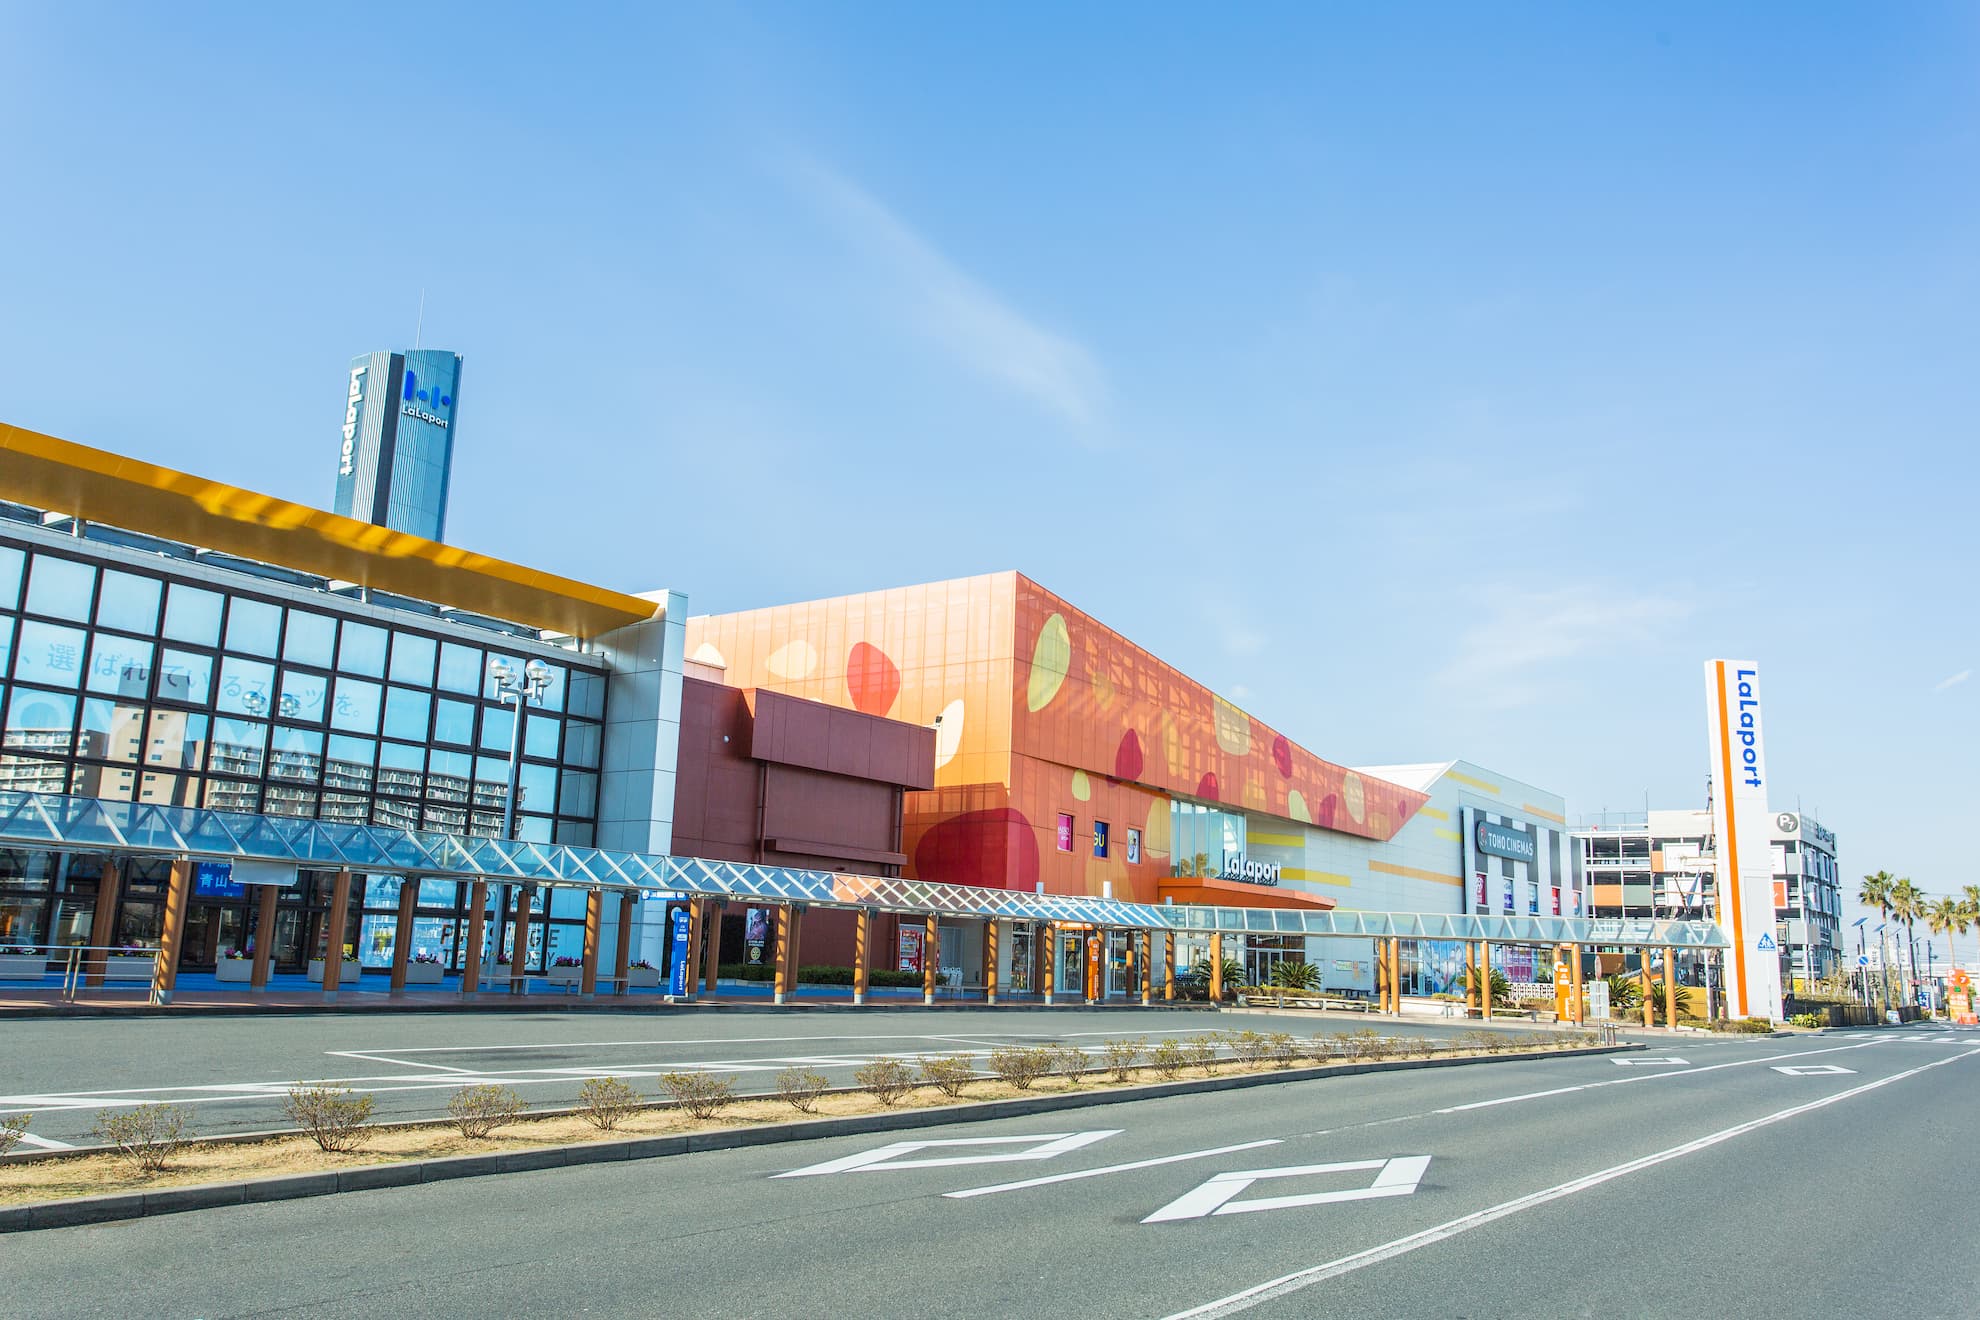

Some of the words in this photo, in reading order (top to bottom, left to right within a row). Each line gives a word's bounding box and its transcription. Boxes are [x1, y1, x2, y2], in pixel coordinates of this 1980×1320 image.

[340, 367, 367, 476] LaLaport
[402, 404, 449, 429] LaLaport
[1736, 669, 1761, 788] LaLaport
[1093, 831, 1105, 847] GU
[1488, 832, 1506, 850] TOHO
[1507, 837, 1533, 856] CINEMAS
[1224, 848, 1281, 884] LaLaport
